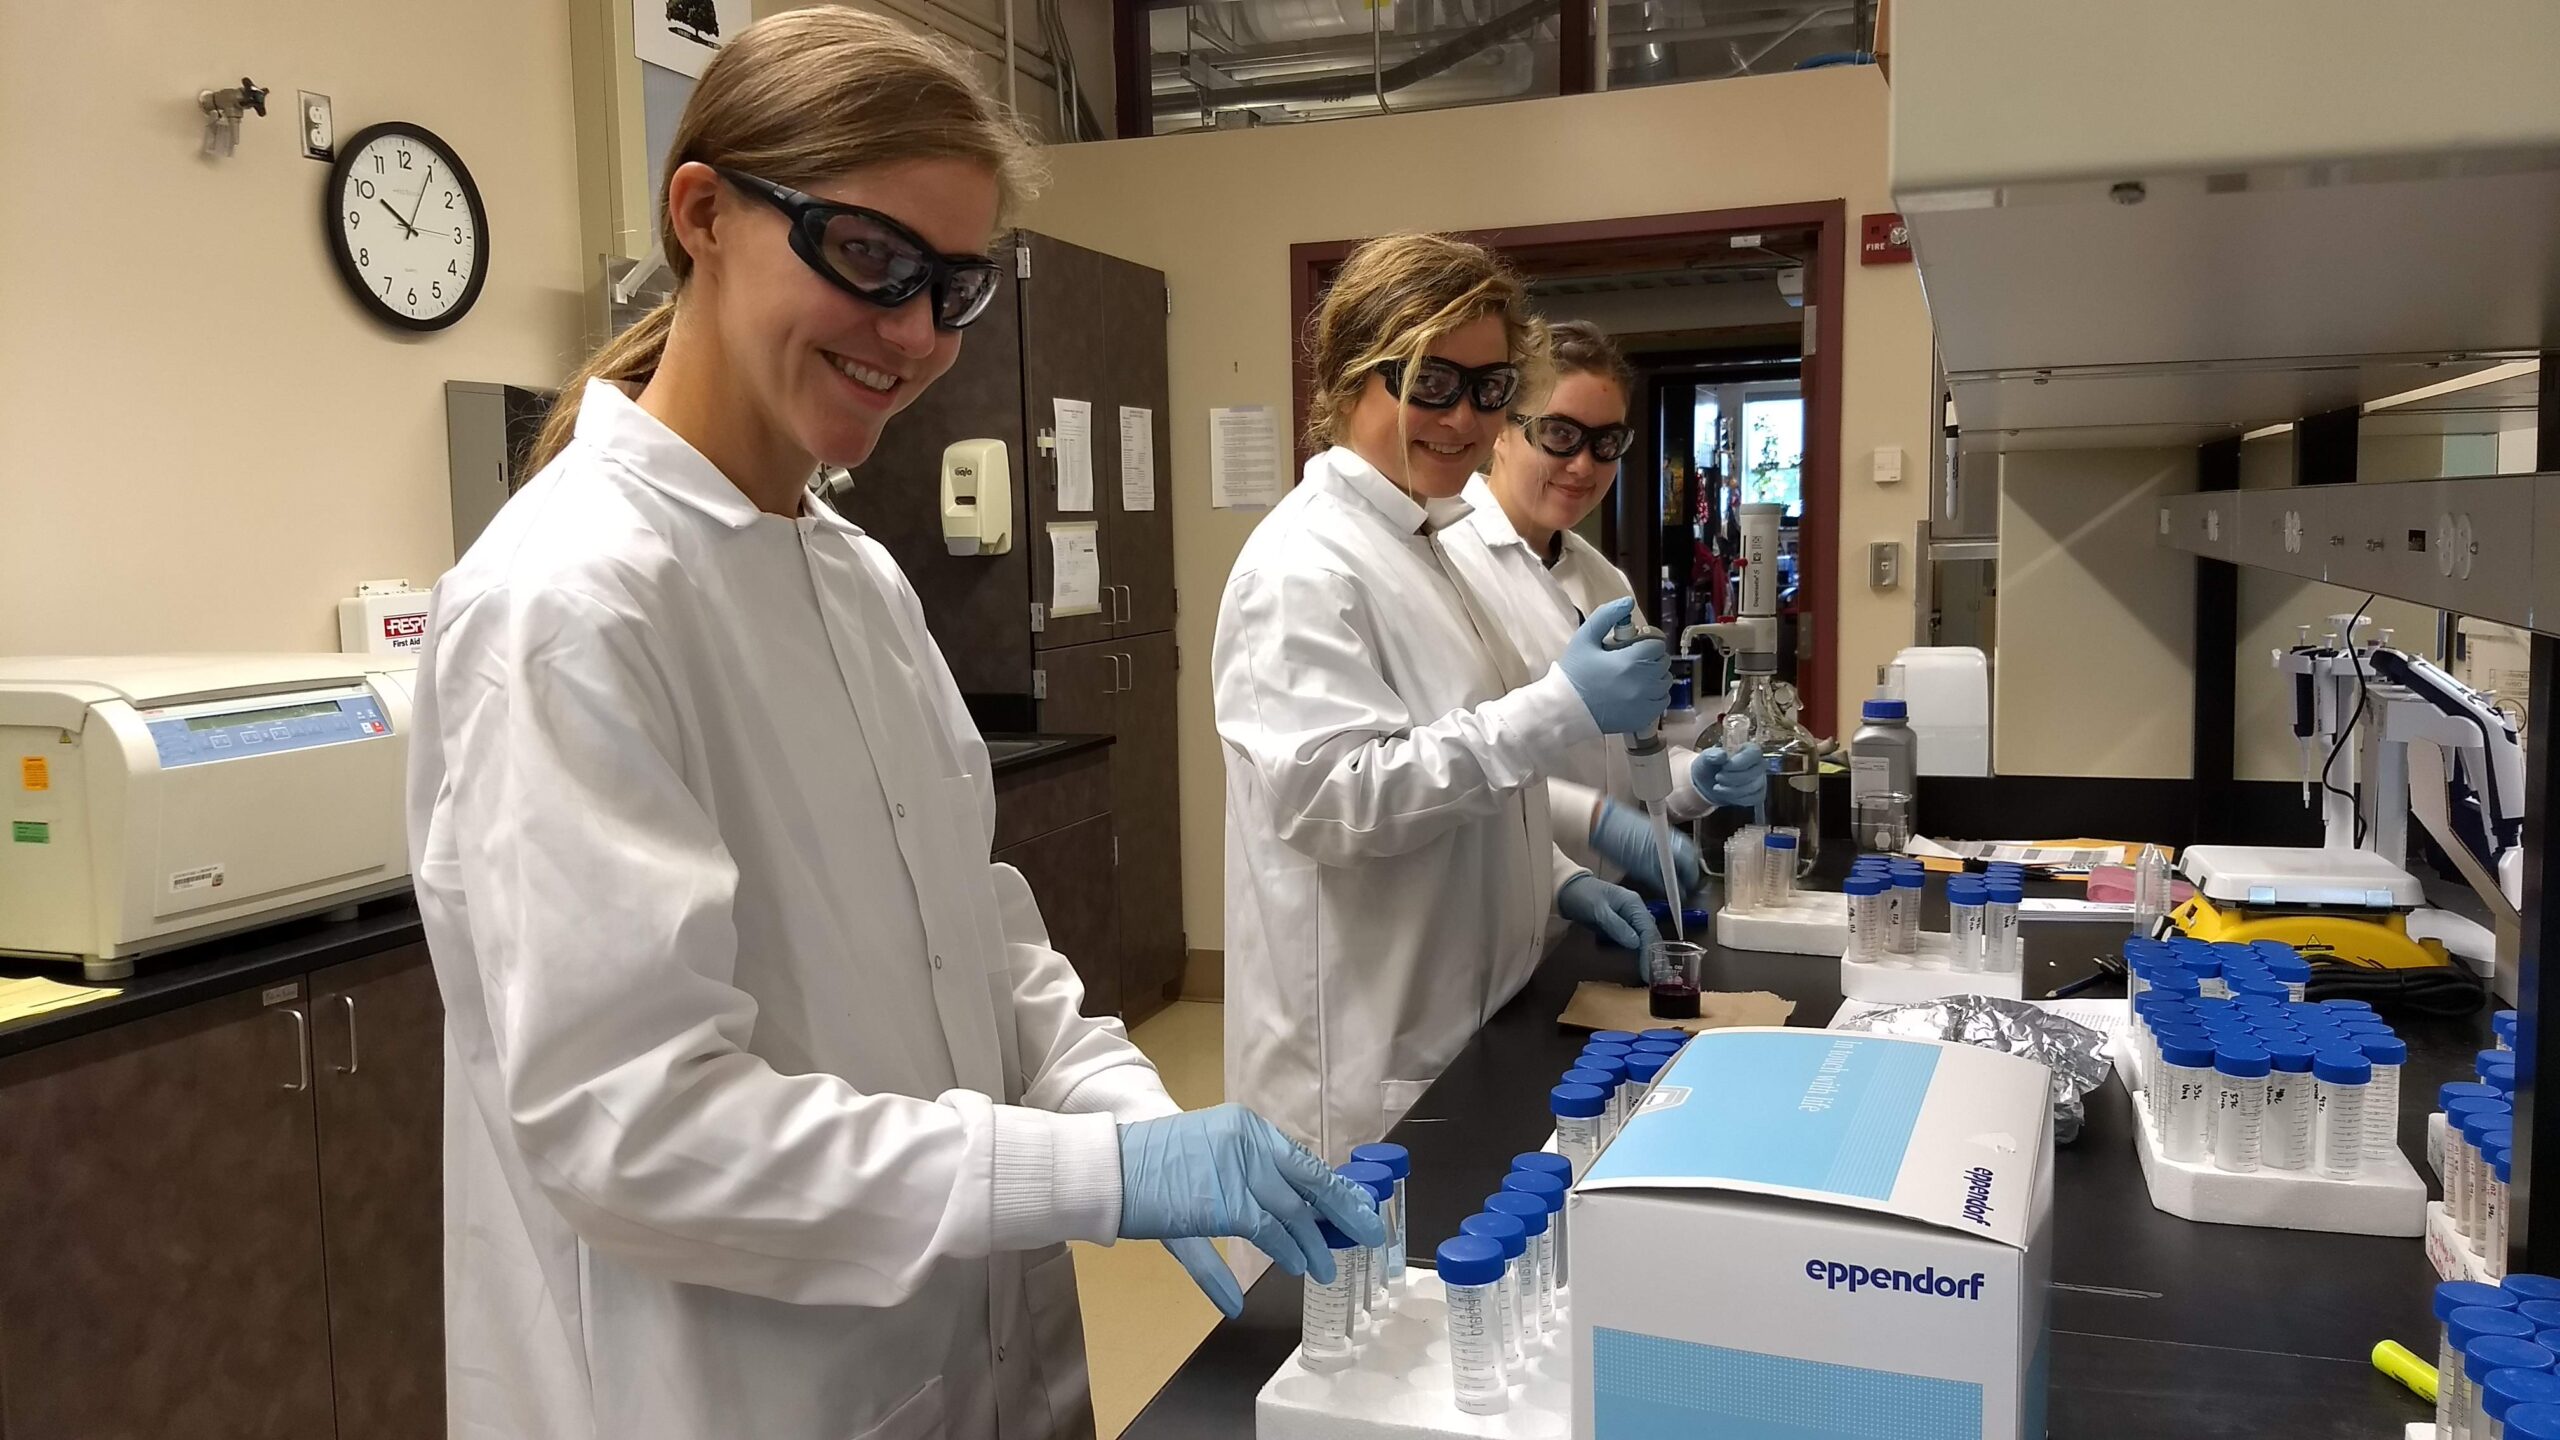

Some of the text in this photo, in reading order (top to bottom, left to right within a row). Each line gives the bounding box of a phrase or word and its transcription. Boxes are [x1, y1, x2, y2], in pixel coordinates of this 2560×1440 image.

[373, 155, 385, 175] 11
[397, 150, 412, 170] 12
[426, 165, 433, 183] 1
[354, 178, 375, 199] 10
[444, 191, 454, 210] 2
[349, 211, 360, 230] 9
[453, 227, 463, 245] 3
[1866, 242, 1886, 251] FIRE
[359, 248, 370, 267] 8
[447, 259, 458, 276] 4
[383, 276, 393, 295] 7
[431, 281, 442, 299] 5
[407, 288, 418, 306] 6
[393, 637, 421, 648] First Aid
[1798, 1040, 1863, 1112] In touch with life
[1962, 1166, 1994, 1227] eppendorf
[1805, 1258, 1985, 1301] eppendorf
